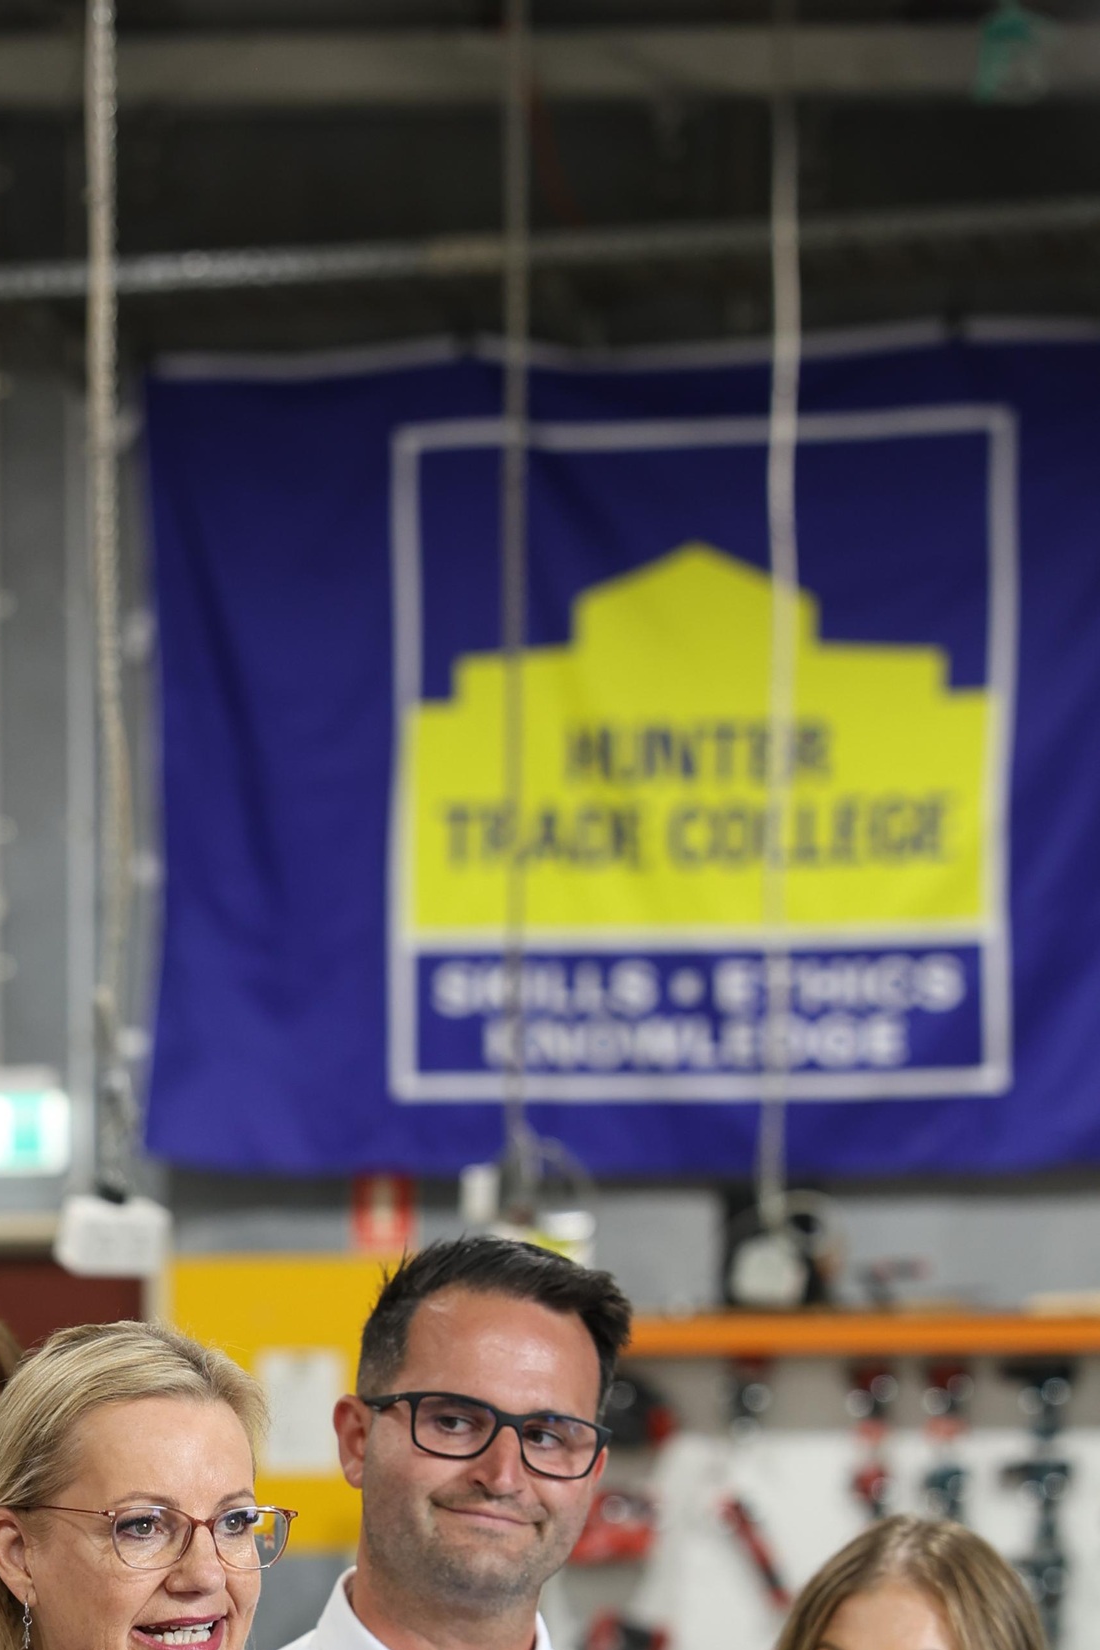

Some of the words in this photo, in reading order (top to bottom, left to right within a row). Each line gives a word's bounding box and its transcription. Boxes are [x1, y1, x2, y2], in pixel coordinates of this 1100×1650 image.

[565, 720, 834, 786] HUNTER
[665, 793, 956, 870] COLLEGE
[433, 960, 658, 1016] SKILLS
[484, 1014, 909, 1069] KNOWLEDGE
